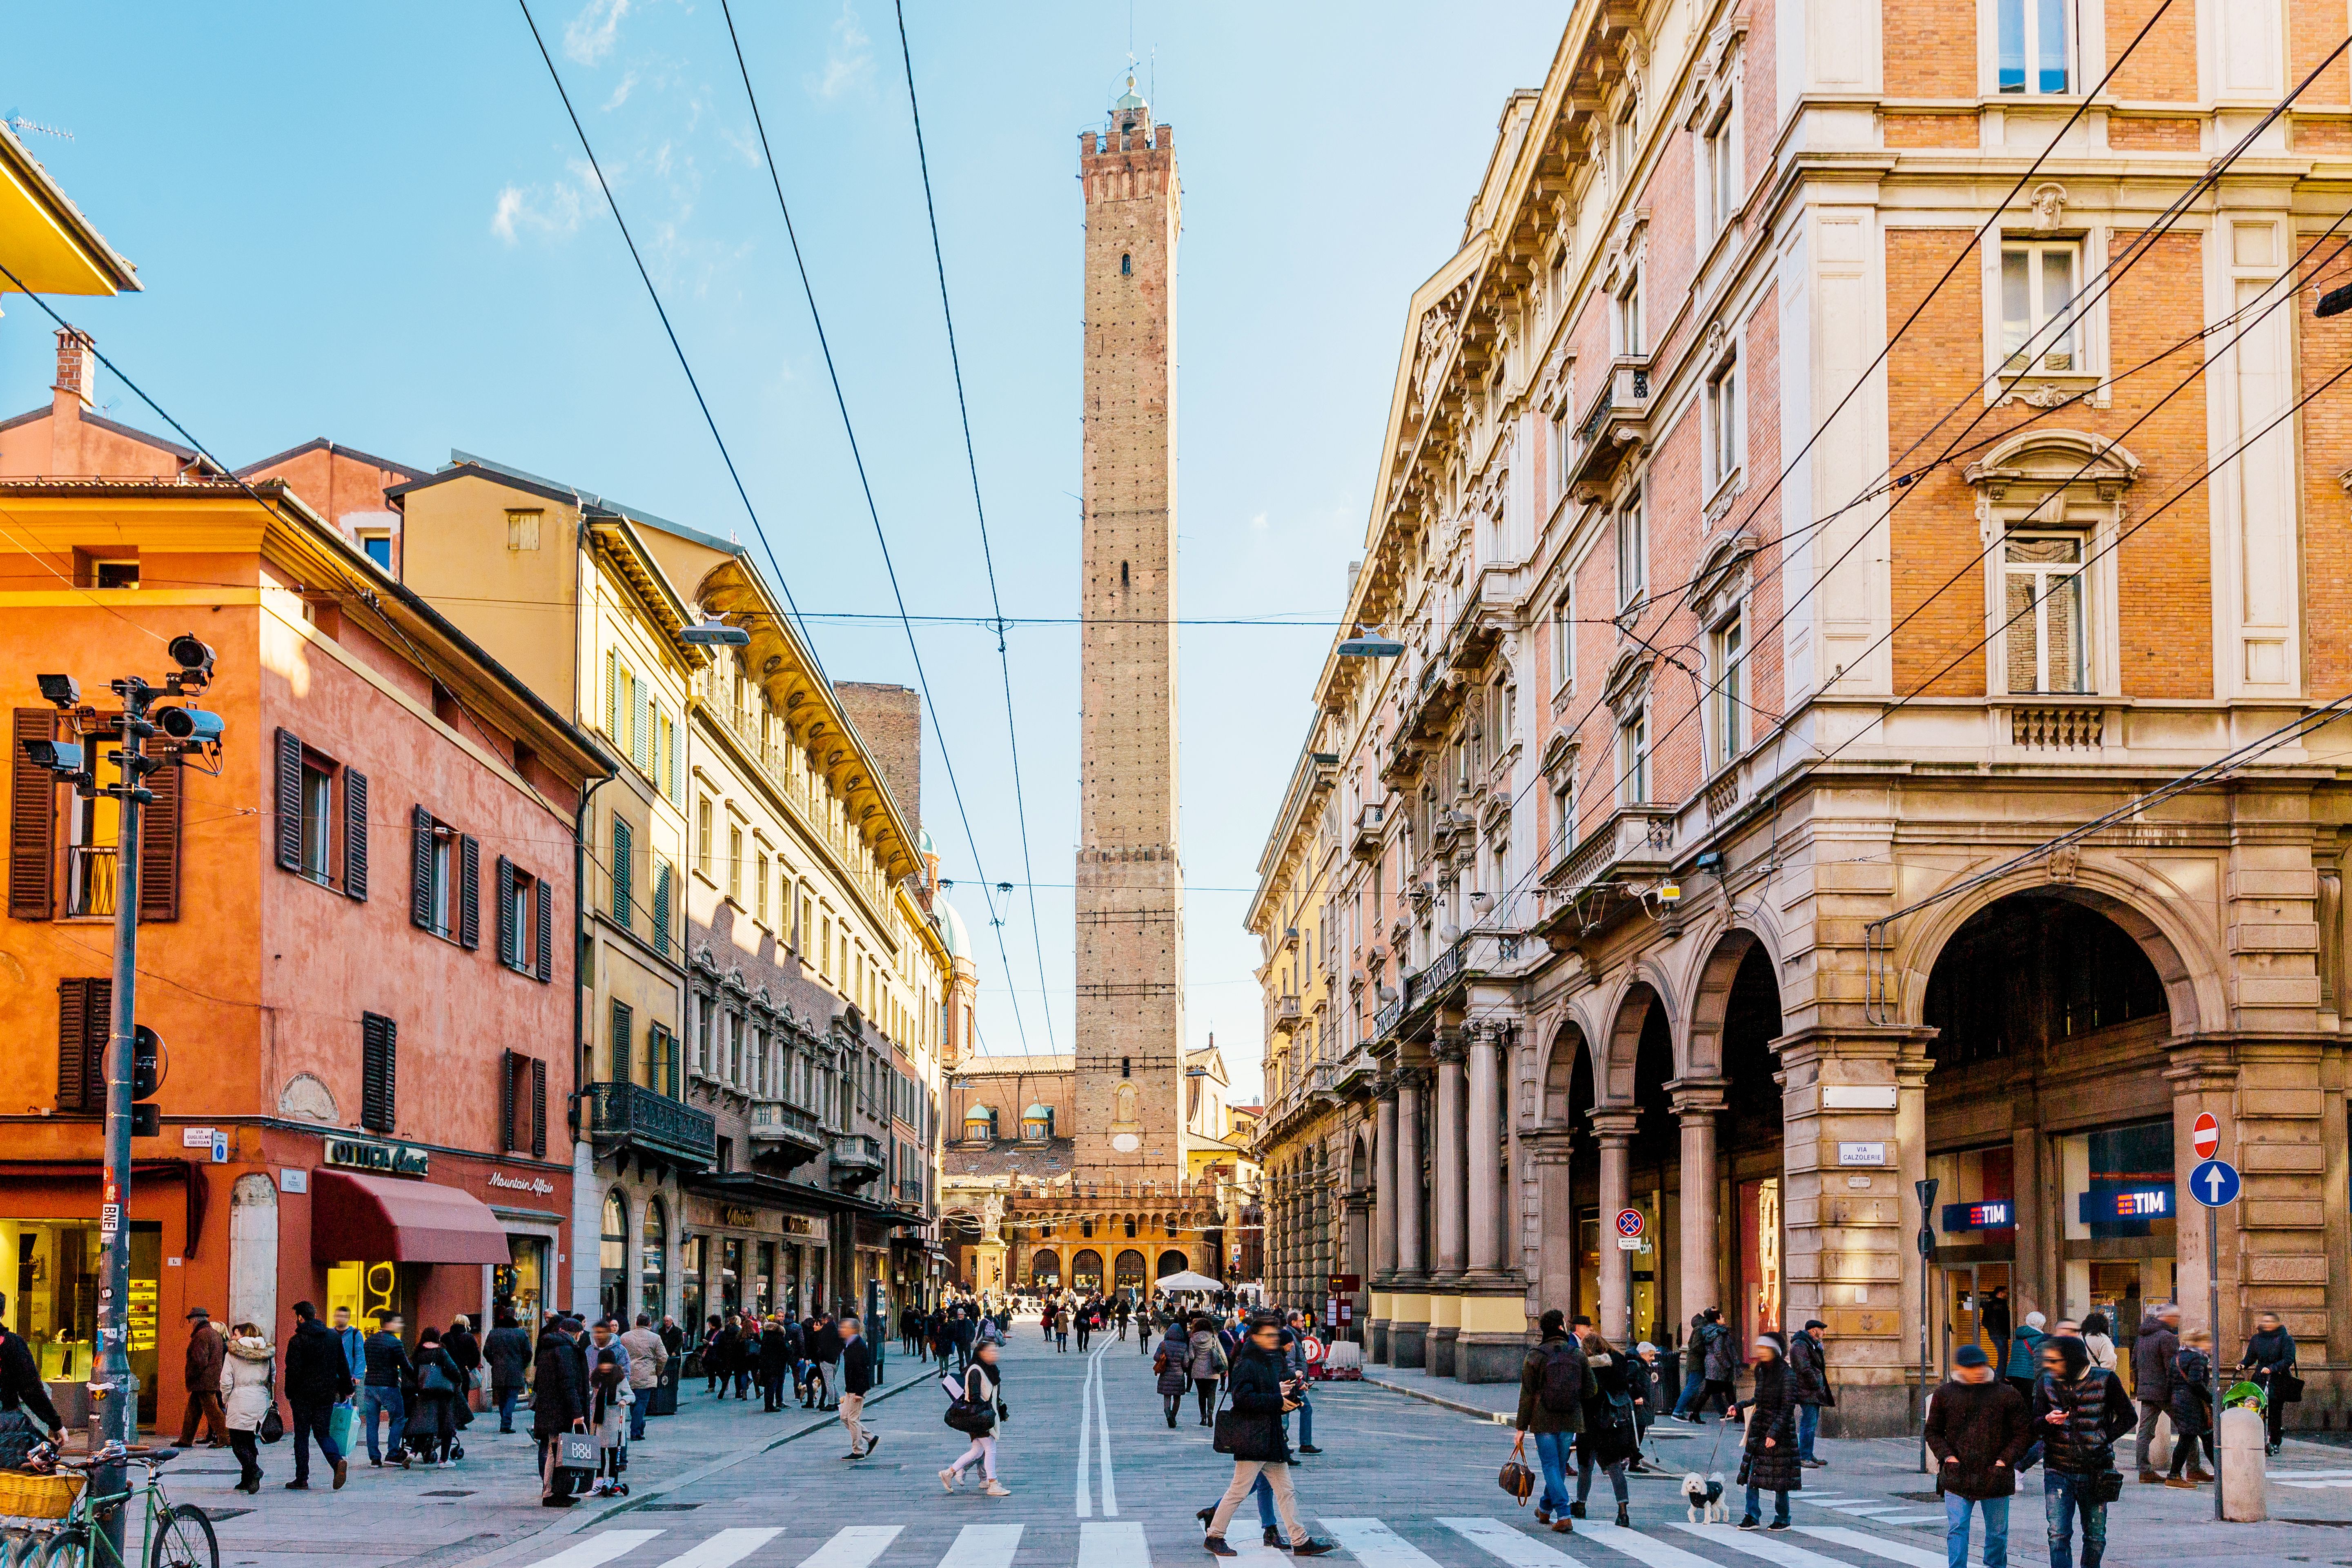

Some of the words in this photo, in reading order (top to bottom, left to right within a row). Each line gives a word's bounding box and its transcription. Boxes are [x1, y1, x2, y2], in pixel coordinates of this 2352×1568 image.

[1434, 899, 1446, 907] 14
[1422, 948, 1457, 998] GENERALI
[332, 1140, 391, 1168] OTTICA
[488, 1172, 531, 1191] Mountain
[532, 1177, 553, 1197] Affair
[2134, 1191, 2164, 1214] TIM
[104, 1207, 117, 1228] BNE
[1982, 1204, 2005, 1224] TIM
[1639, 1236, 1653, 1255] coin
[572, 1442, 591, 1452] DOU
